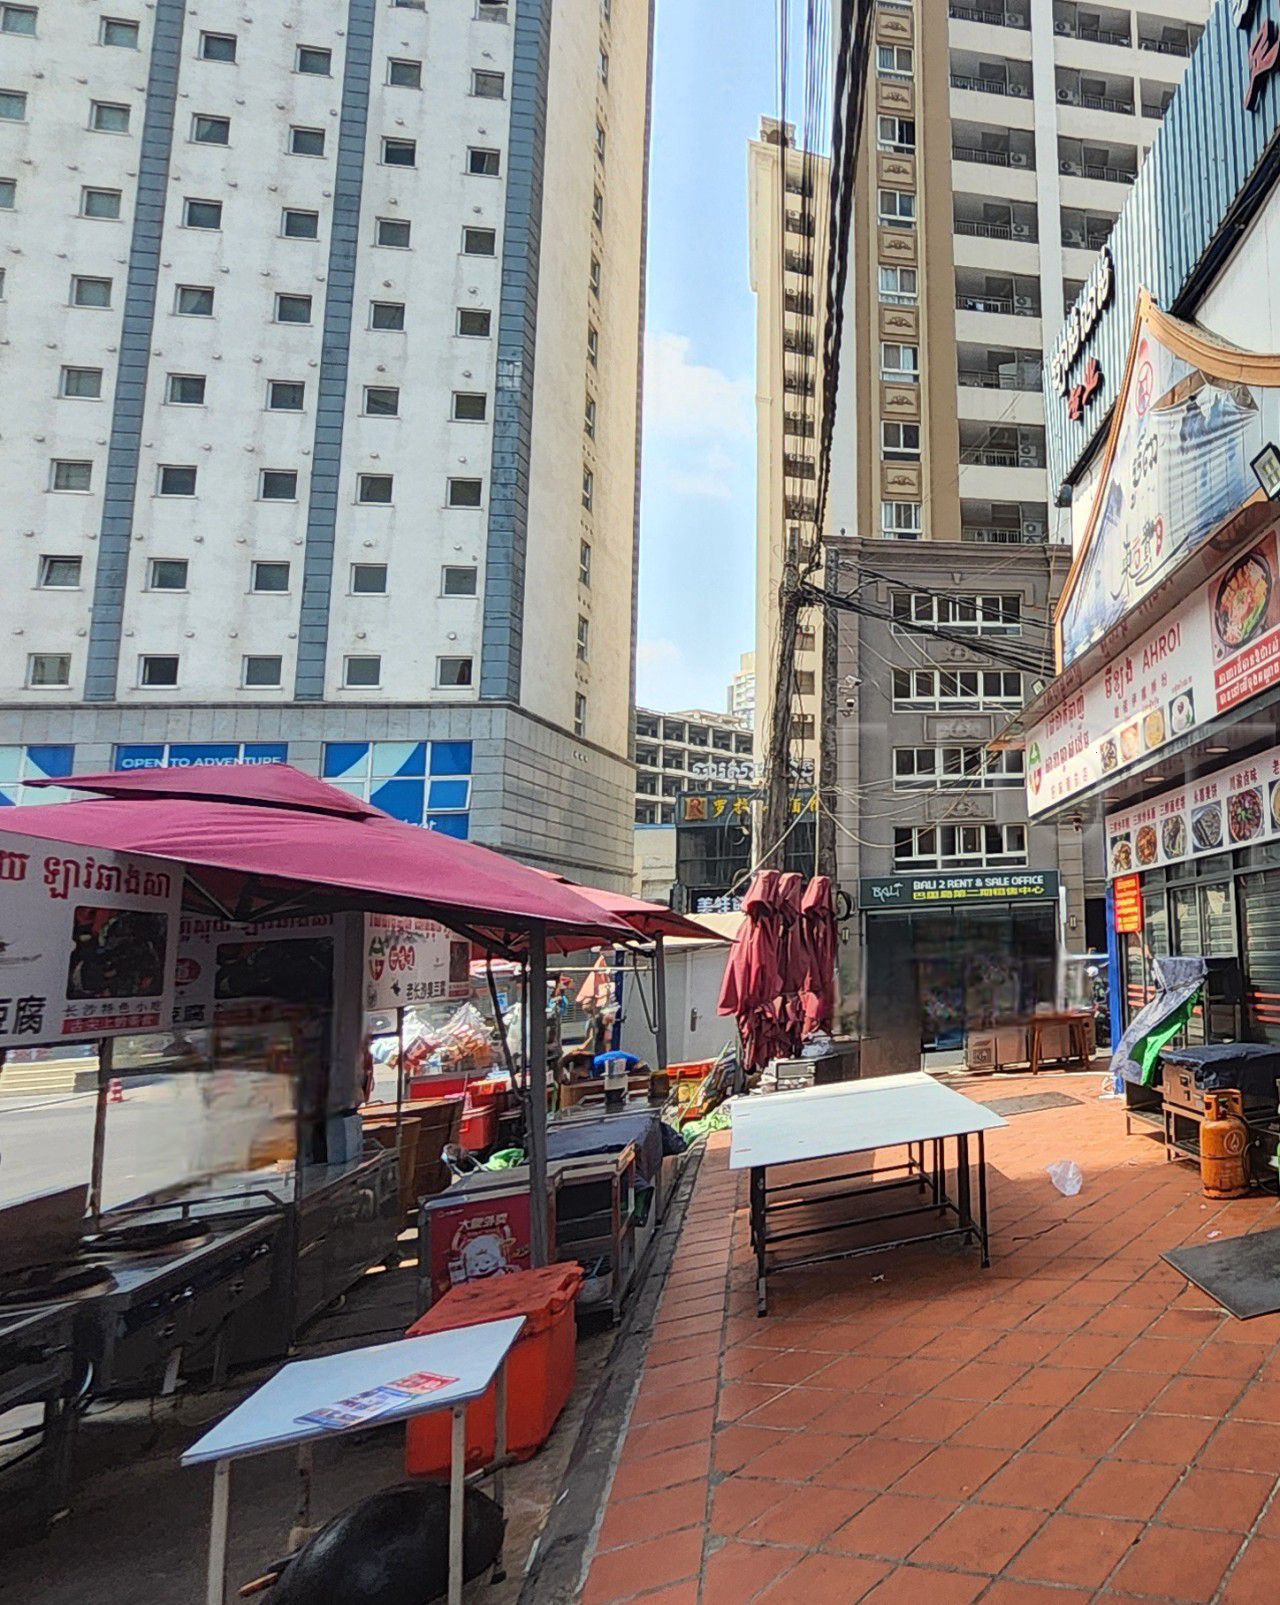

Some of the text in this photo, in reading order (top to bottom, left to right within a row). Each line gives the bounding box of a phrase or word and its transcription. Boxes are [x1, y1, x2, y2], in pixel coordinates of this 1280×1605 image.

[1142, 622, 1181, 674] AHROI
[121, 757, 165, 769] OPEN
[170, 757, 191, 767] TO
[913, 875, 1044, 890] BALI 2 RENT & SALE OFFICE
